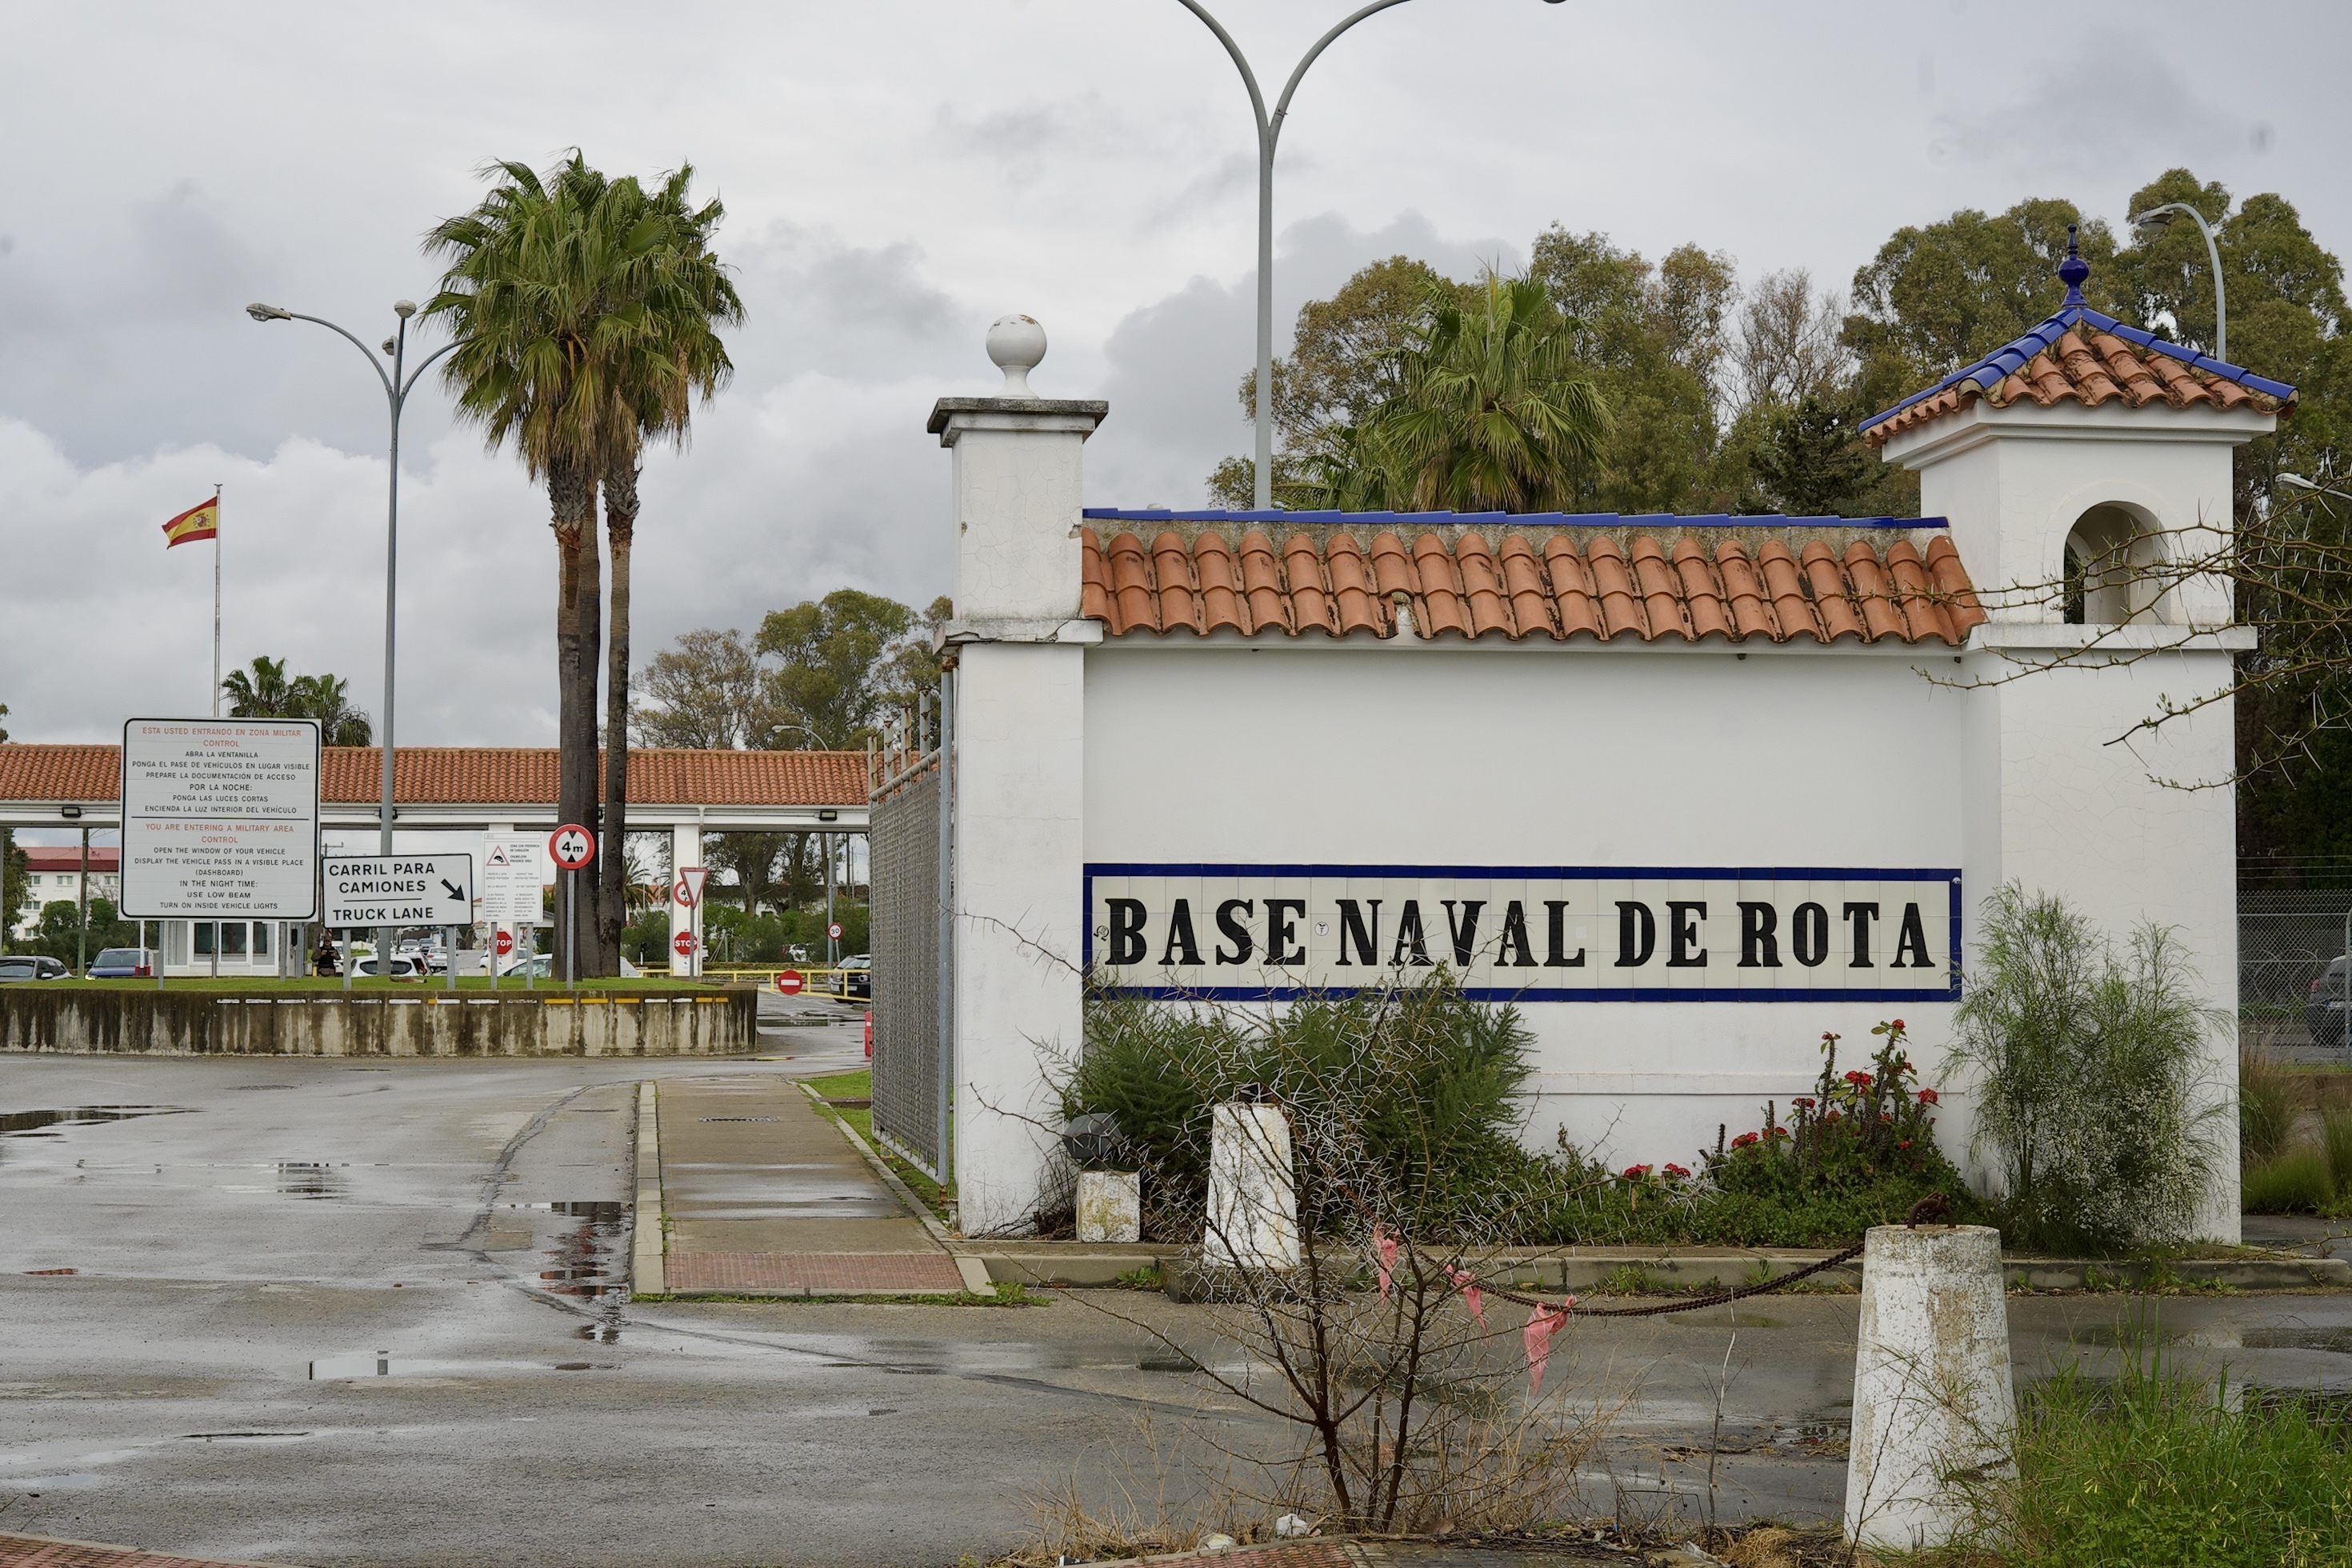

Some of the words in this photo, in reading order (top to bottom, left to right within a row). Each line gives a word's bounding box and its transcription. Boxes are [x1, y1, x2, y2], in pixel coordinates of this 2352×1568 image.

[142, 727, 160, 735] ESTA
[164, 727, 189, 735] USTED
[192, 728, 232, 736] ENTRANDO
[236, 728, 245, 736] EN
[250, 728, 269, 736] ZONA
[273, 729, 301, 737] MILITAR
[329, 864, 387, 877] CARRIL
[394, 862, 434, 875] PARA
[339, 880, 426, 894] CAMIONES
[333, 909, 387, 921] TRUCK
[393, 907, 434, 919] LANE
[1105, 898, 1306, 966] BASE
[1334, 899, 1586, 967] NAVAL
[1614, 902, 1707, 967] DE
[1737, 902, 1935, 967] ROTA
